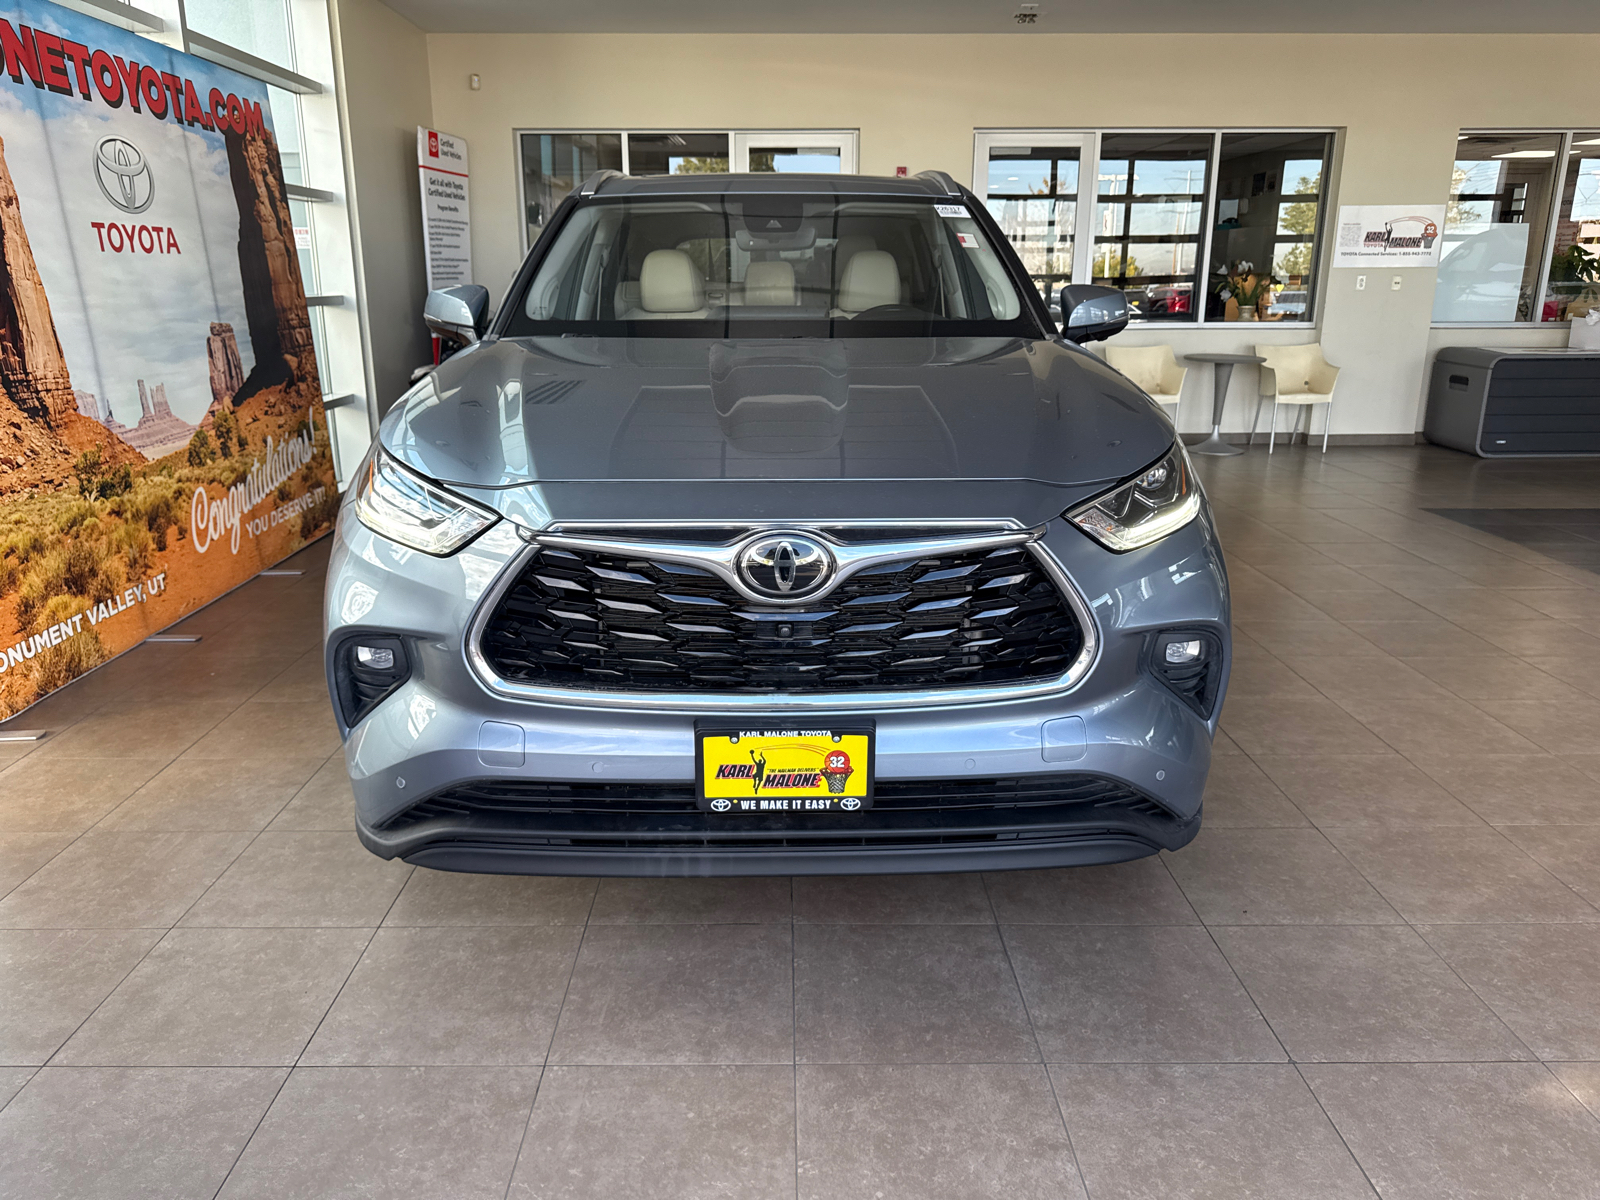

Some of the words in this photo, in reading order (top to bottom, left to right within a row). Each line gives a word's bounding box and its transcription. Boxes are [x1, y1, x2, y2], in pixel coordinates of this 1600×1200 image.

[0, 18, 266, 139] NETOYOTA.COM
[440, 138, 454, 149] Certified
[428, 188, 443, 197] Certified
[452, 181, 463, 191] Toyota
[91, 222, 181, 255] TOYOTA
[1363, 231, 1387, 242] KARL
[1388, 237, 1422, 248] MALONE
[192, 407, 318, 555] Congratulations!
[245, 515, 269, 538] YOU
[270, 492, 314, 527] DESERVE
[86, 584, 147, 626] VALLEY,
[147, 573, 166, 596] UT
[829, 756, 844, 768] 32
[715, 764, 756, 779] KARL
[762, 773, 822, 788] MALONE
[740, 800, 757, 810] WE
[760, 800, 789, 810] MAKE
[792, 800, 802, 809] IT
[805, 799, 831, 809] EASY
